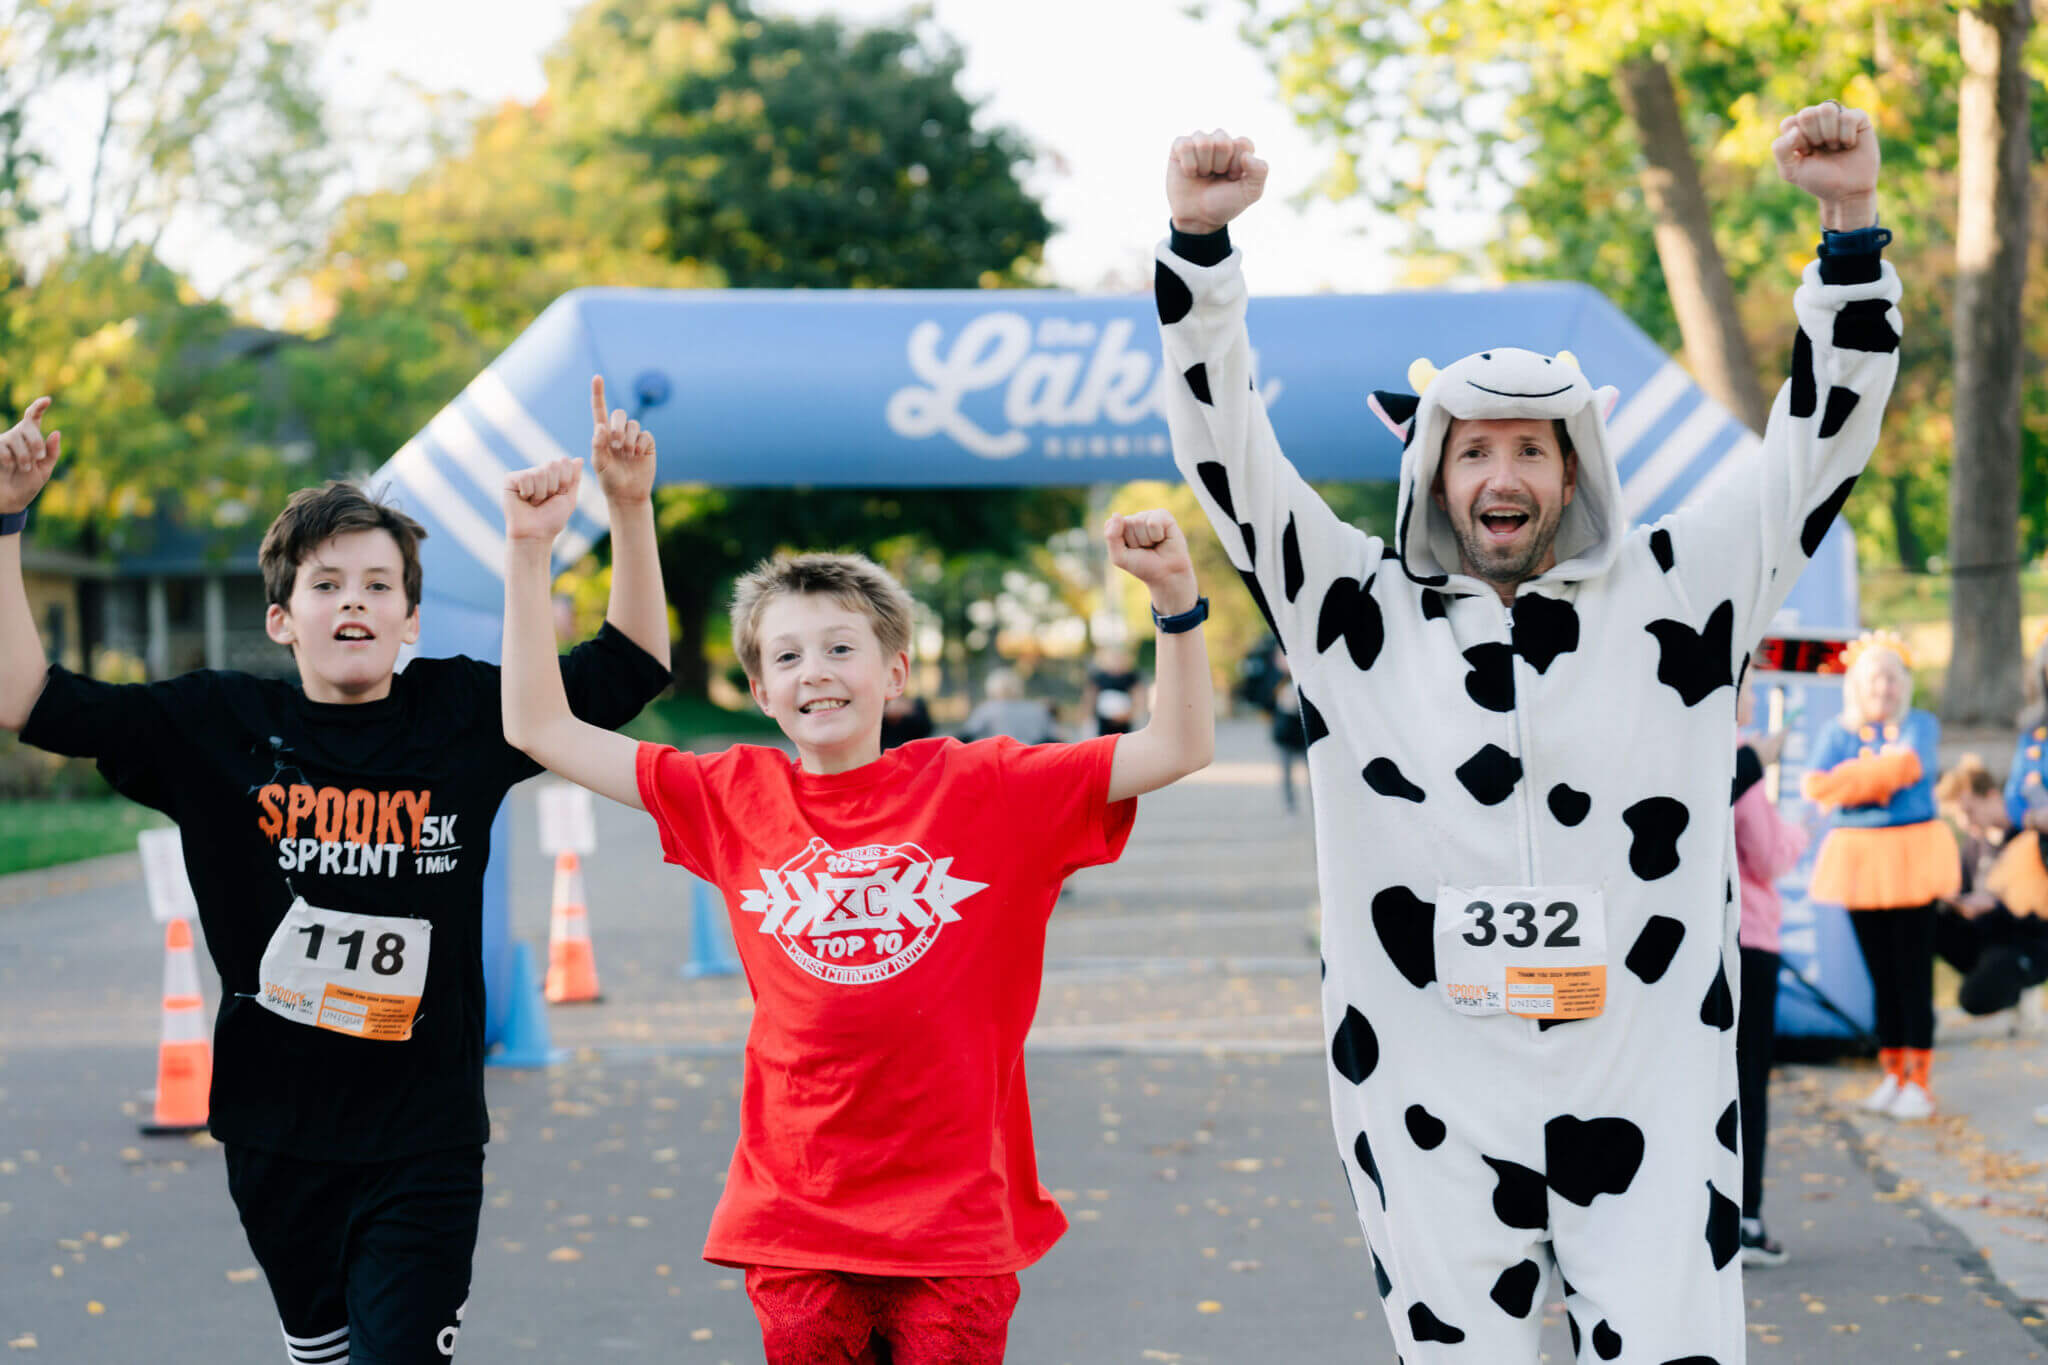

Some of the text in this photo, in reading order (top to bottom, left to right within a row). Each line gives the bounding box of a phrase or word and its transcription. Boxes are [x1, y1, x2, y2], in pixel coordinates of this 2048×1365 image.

[886, 311, 1283, 461] Lak
[257, 783, 432, 852] SPOOKY
[420, 814, 458, 847] 5K
[278, 837, 405, 877] SPRINT
[415, 856, 424, 875] 1
[820, 882, 891, 923] XC
[1461, 900, 1581, 948] 332
[298, 923, 406, 976] 118
[811, 932, 904, 959] TOP 10
[825, 963, 890, 984] COUNTRY
[892, 934, 933, 971] INVITE
[1510, 999, 1552, 1010] UNIQUE
